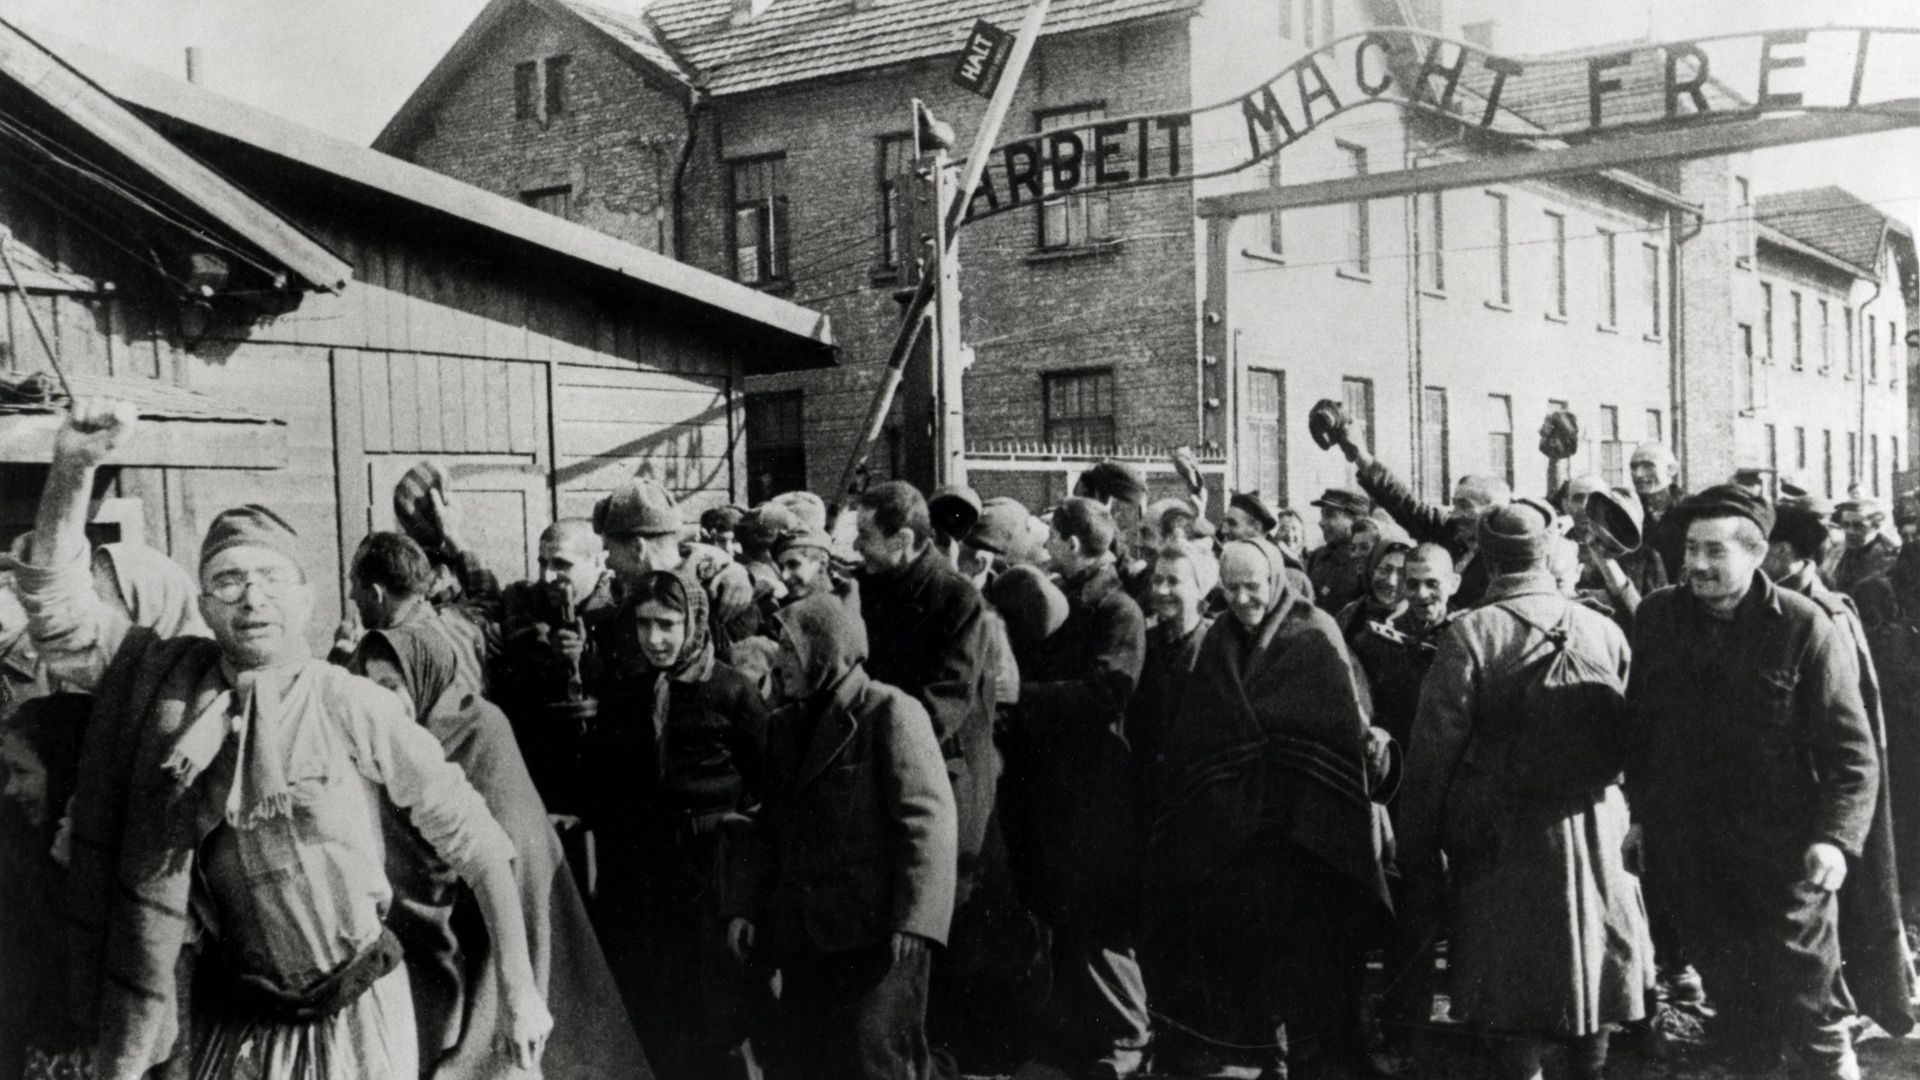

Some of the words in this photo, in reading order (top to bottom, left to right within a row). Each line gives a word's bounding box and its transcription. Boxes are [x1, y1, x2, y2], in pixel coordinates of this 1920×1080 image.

[960, 33, 994, 82] HALT
[967, 116, 1190, 216] ARBEIT
[1241, 31, 1523, 160] MACHT
[1588, 28, 1870, 129] FREI
